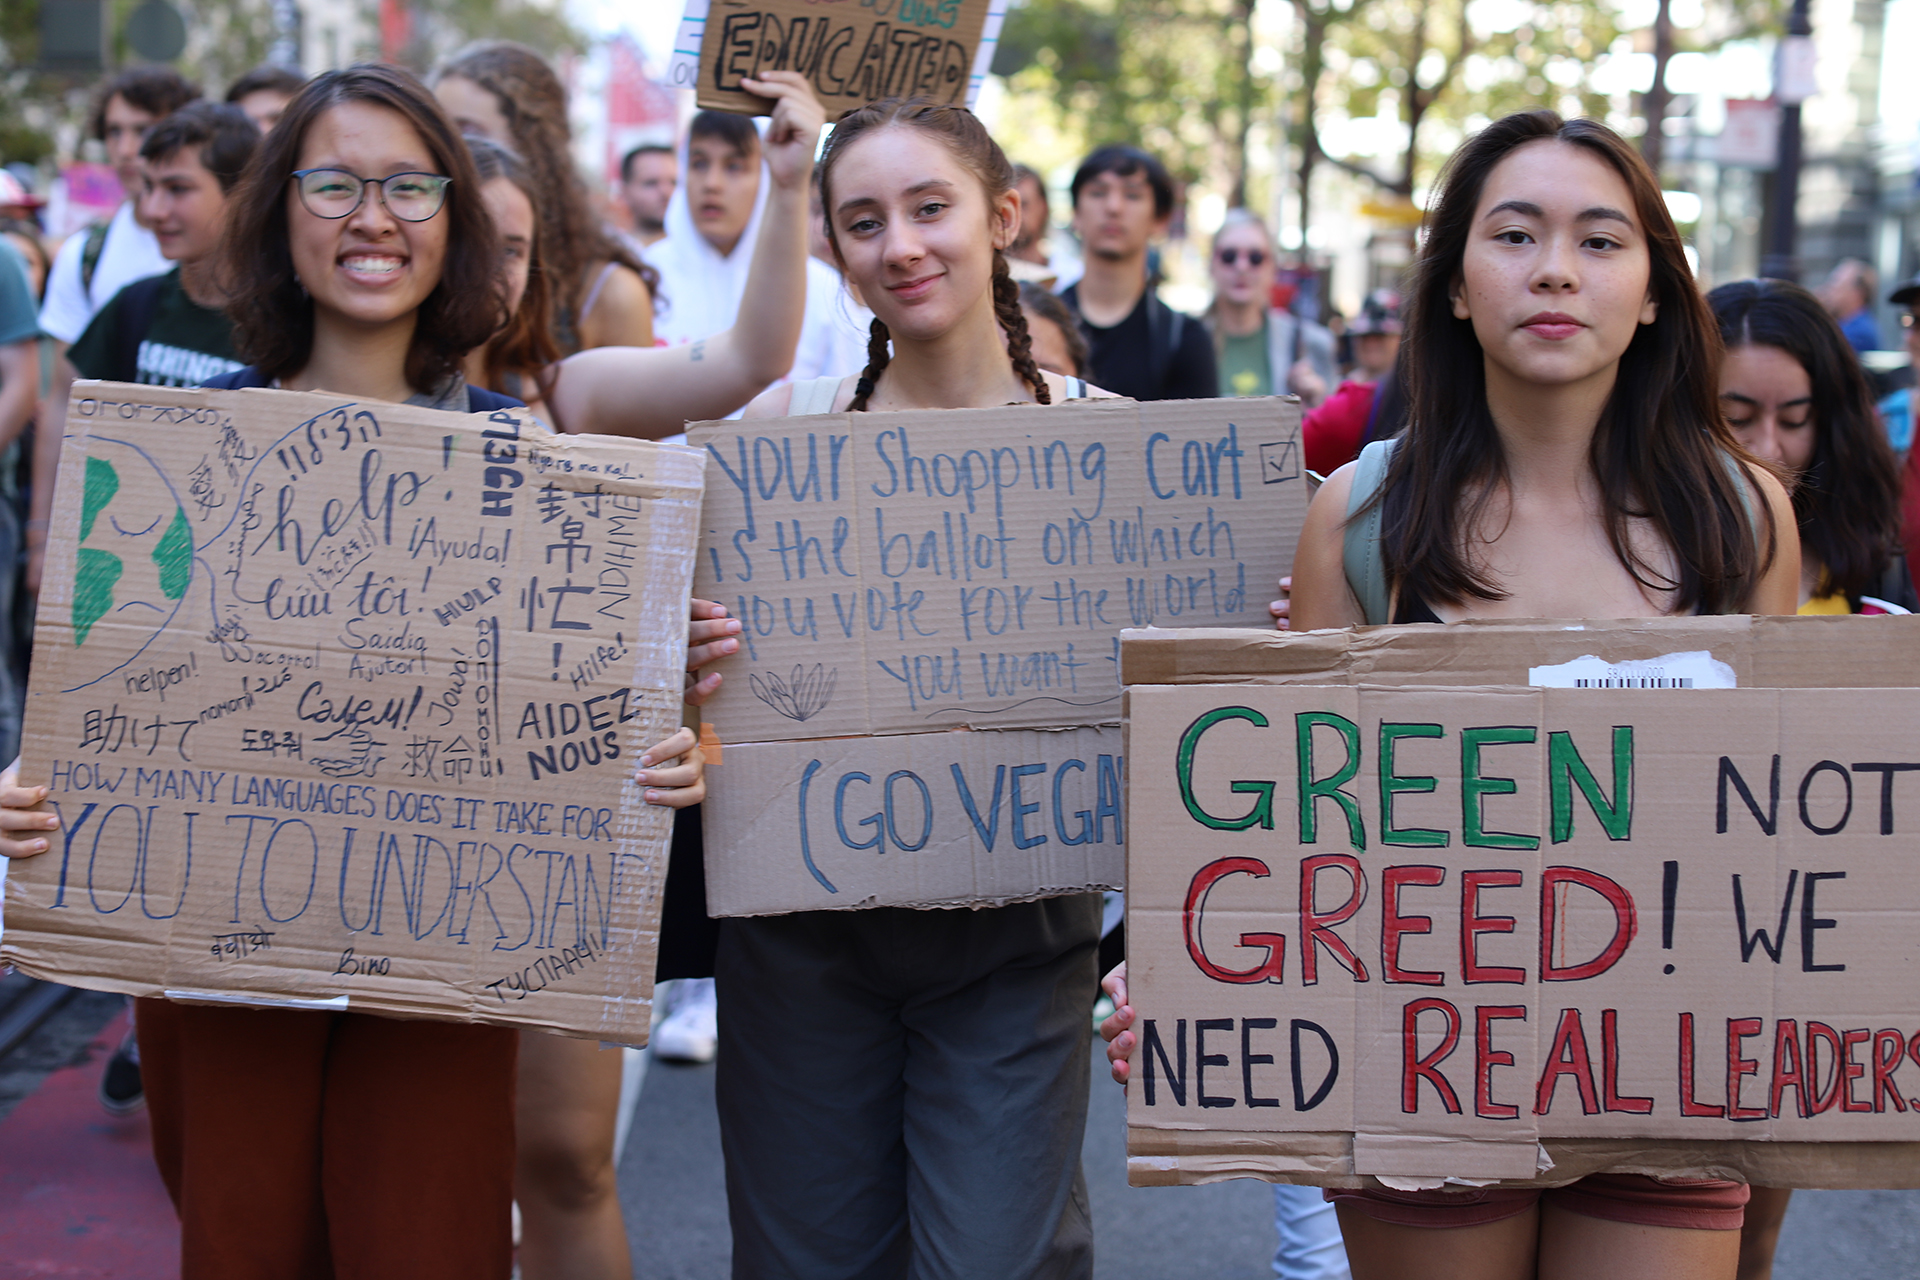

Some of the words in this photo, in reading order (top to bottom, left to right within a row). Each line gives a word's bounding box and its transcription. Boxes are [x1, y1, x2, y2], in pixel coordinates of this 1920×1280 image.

[708, 528, 757, 582] is
[768, 515, 857, 582] the
[875, 506, 1016, 582] ballot
[1041, 517, 1094, 566] on
[1108, 505, 1236, 569] which
[433, 576, 503, 627] HULP
[831, 581, 940, 642] vote
[1039, 577, 1113, 631] the
[123, 651, 200, 701] helpen!
[569, 631, 629, 692] Hilfe!
[876, 647, 964, 712] you
[979, 642, 1090, 698] want
[526, 731, 622, 781] NOUS
[1175, 705, 1635, 854] GREEN
[1716, 753, 1920, 837] NOT
[49, 759, 128, 793] HOW
[134, 766, 226, 804] MANY
[231, 774, 376, 818] LANGUAGES
[385, 788, 446, 825] DOES
[452, 796, 486, 831] IT
[493, 799, 555, 836] TAKE
[561, 804, 614, 842] FOR
[46, 800, 200, 920] YOU
[225, 814, 320, 924] TO
[1182, 853, 1680, 988] GREED!
[1732, 869, 1848, 974] WE
[1141, 1016, 1340, 1113] NEED
[1400, 997, 1655, 1120] REAL
